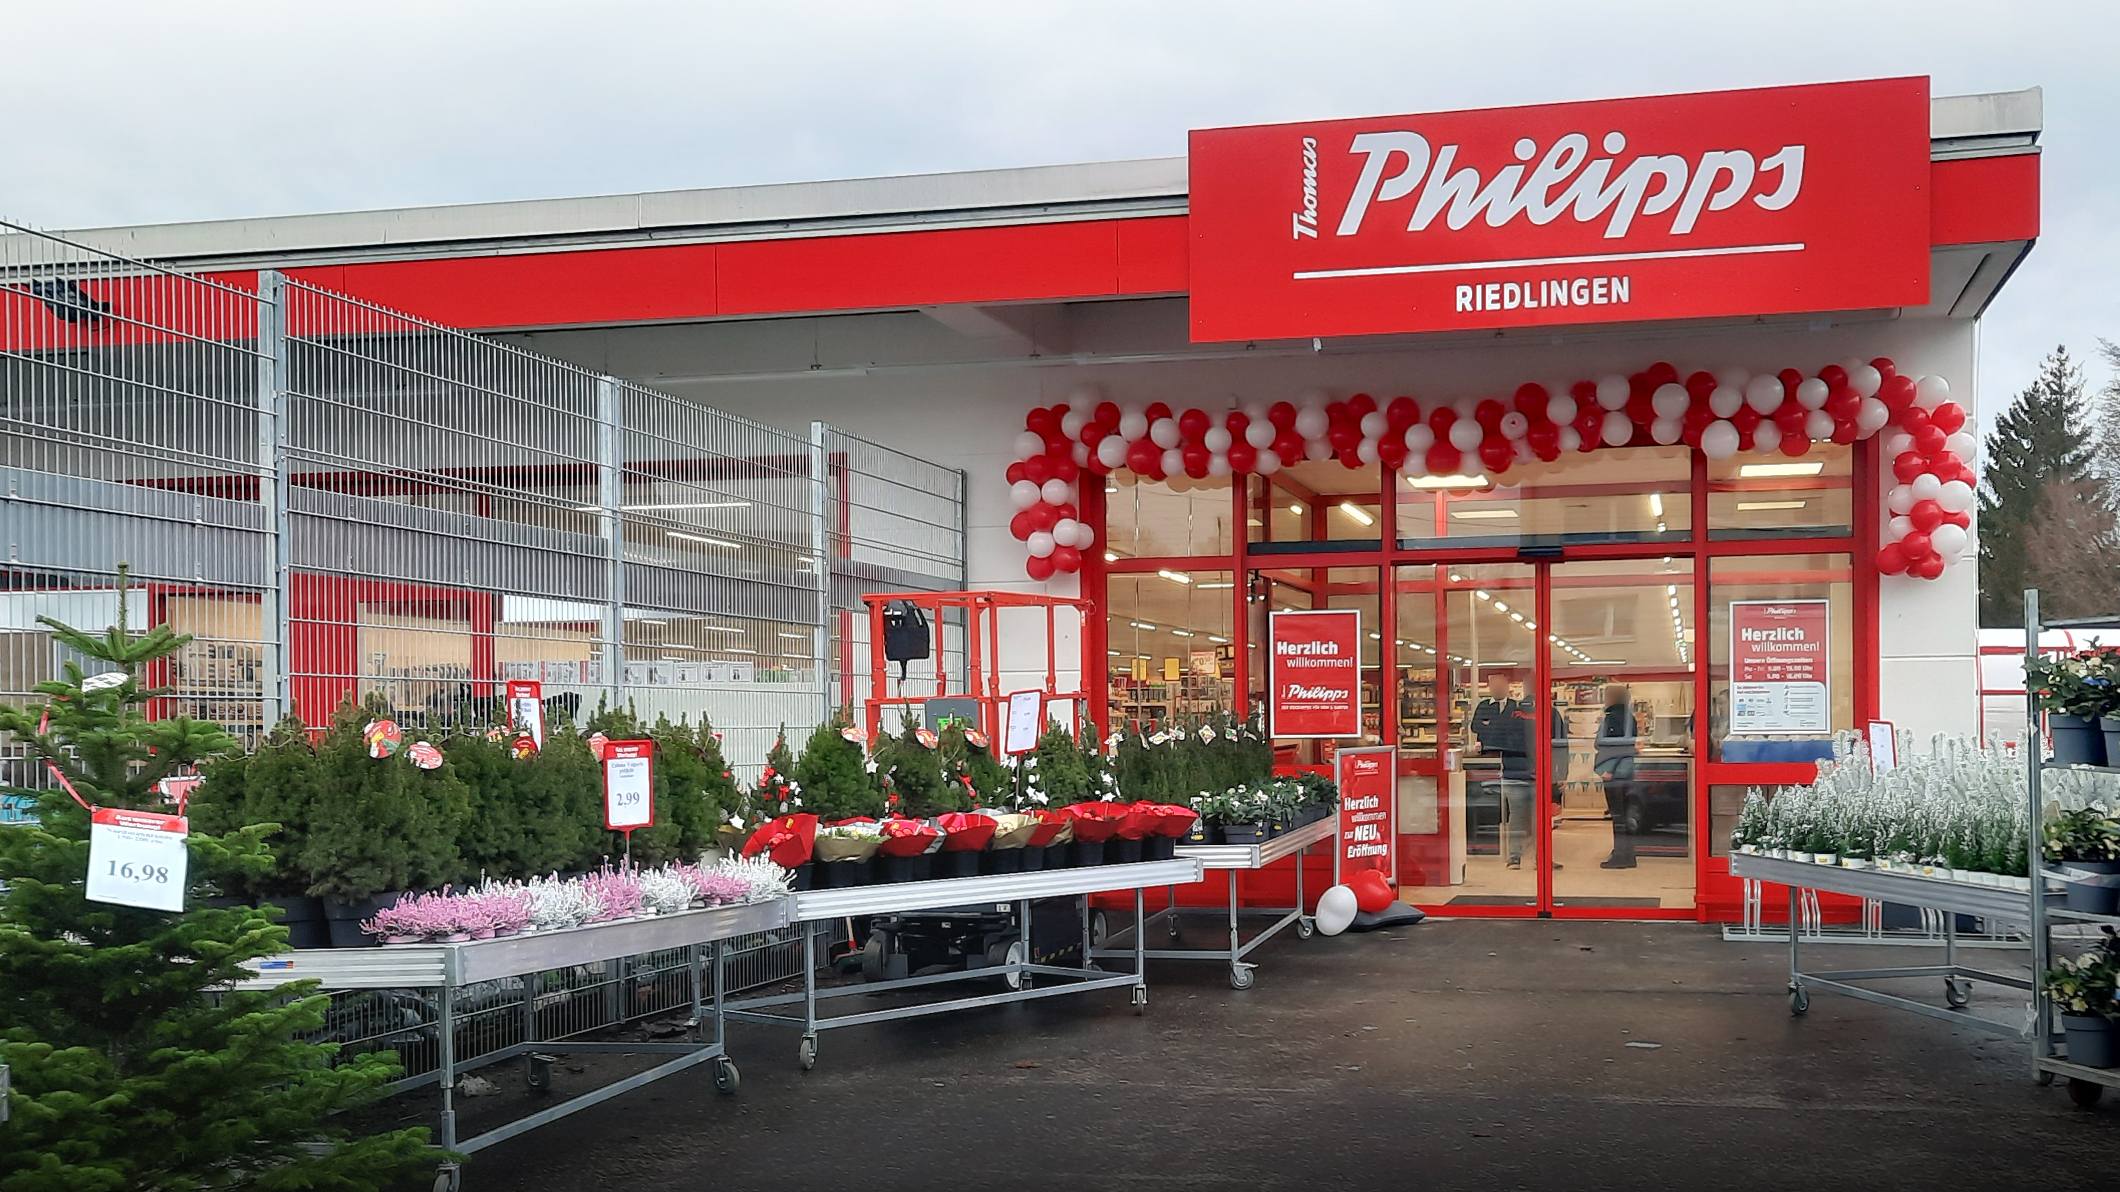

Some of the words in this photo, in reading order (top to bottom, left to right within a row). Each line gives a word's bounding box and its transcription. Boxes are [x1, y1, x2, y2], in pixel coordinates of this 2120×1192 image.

[1294, 136, 1319, 240] Thomas
[1335, 130, 1805, 239] Philipps
[1455, 275, 1631, 312] RIEDLINGEN
[1741, 627, 1805, 641] Herzlich
[1277, 641, 1339, 655] Herzlich
[1751, 641, 1820, 652] willkommen!
[1286, 657, 1354, 668] willkommen!
[1286, 683, 1349, 701] Philipps
[1344, 795, 1379, 811] Herzlich
[1354, 823, 1378, 842] NEU
[1347, 843, 1388, 859] Eröffnung
[107, 860, 169, 884] 16,98
